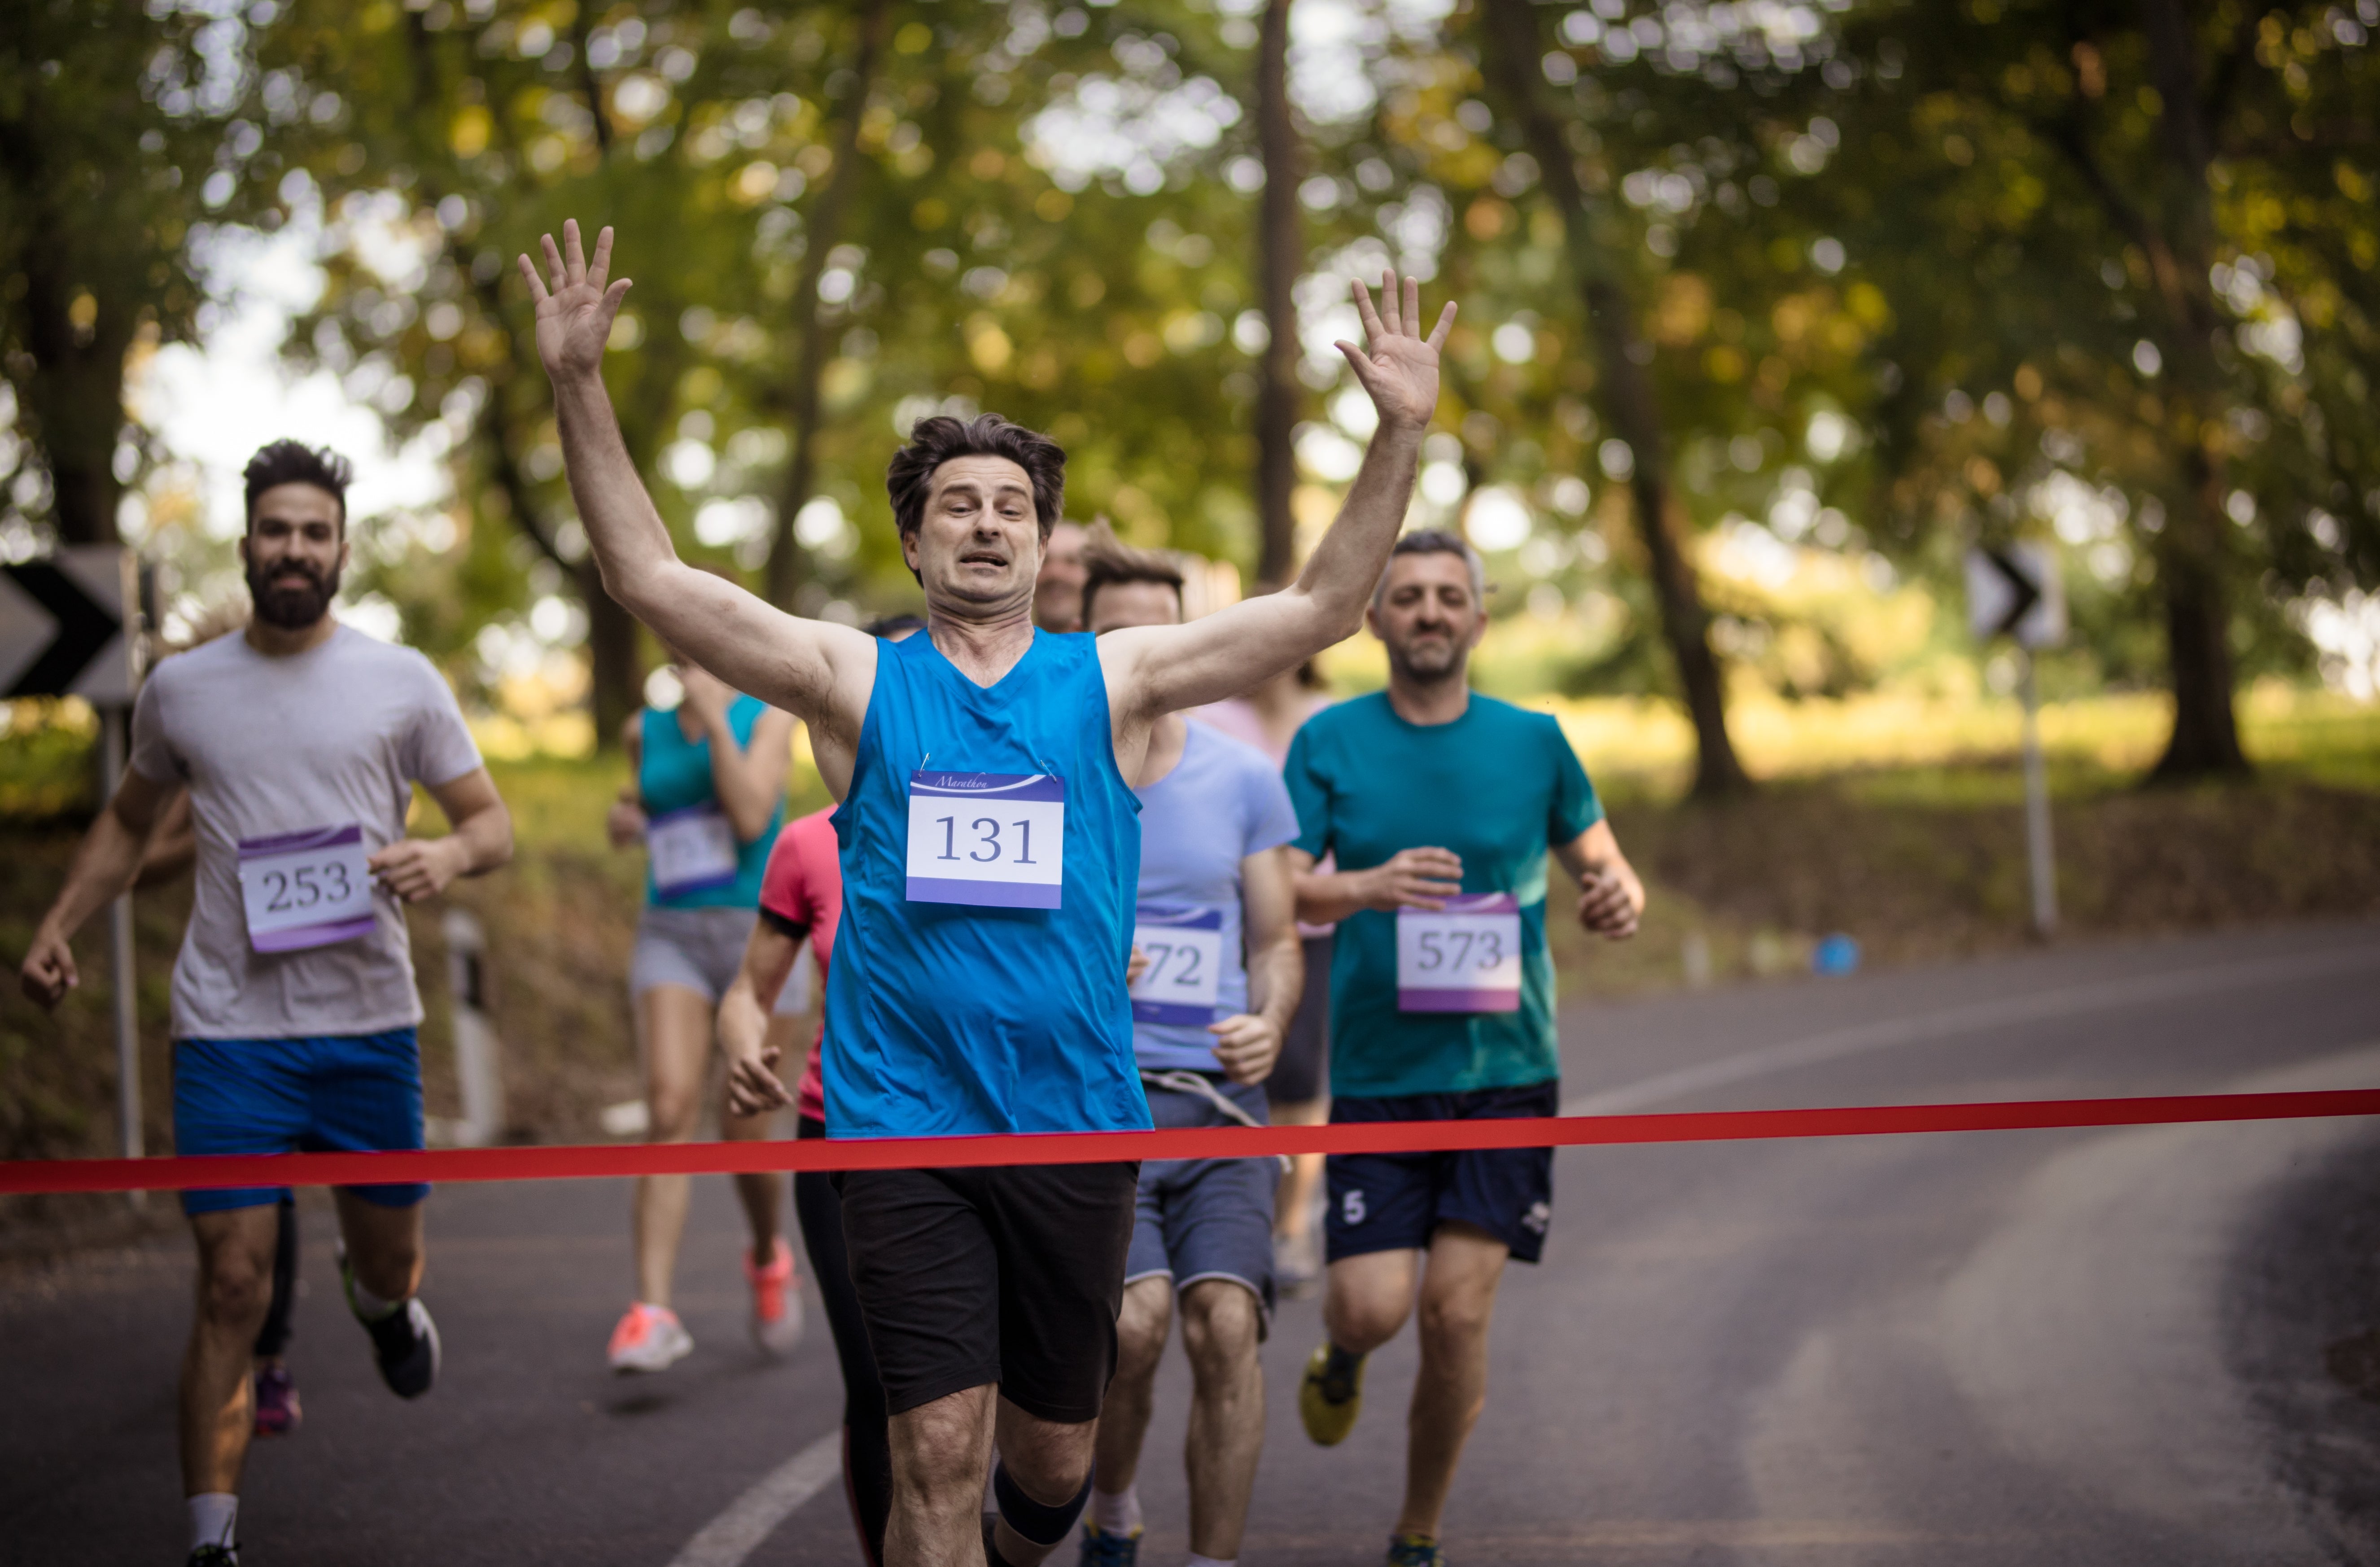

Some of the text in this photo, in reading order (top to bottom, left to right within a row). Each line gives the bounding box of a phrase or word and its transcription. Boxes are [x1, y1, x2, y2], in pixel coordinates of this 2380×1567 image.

[935, 772, 989, 788] Marathon
[936, 816, 1037, 864] 131
[262, 861, 350, 912] 253
[1146, 943, 1201, 986] 72
[1418, 931, 1502, 972] 573
[1343, 1190, 1367, 1225] 5
